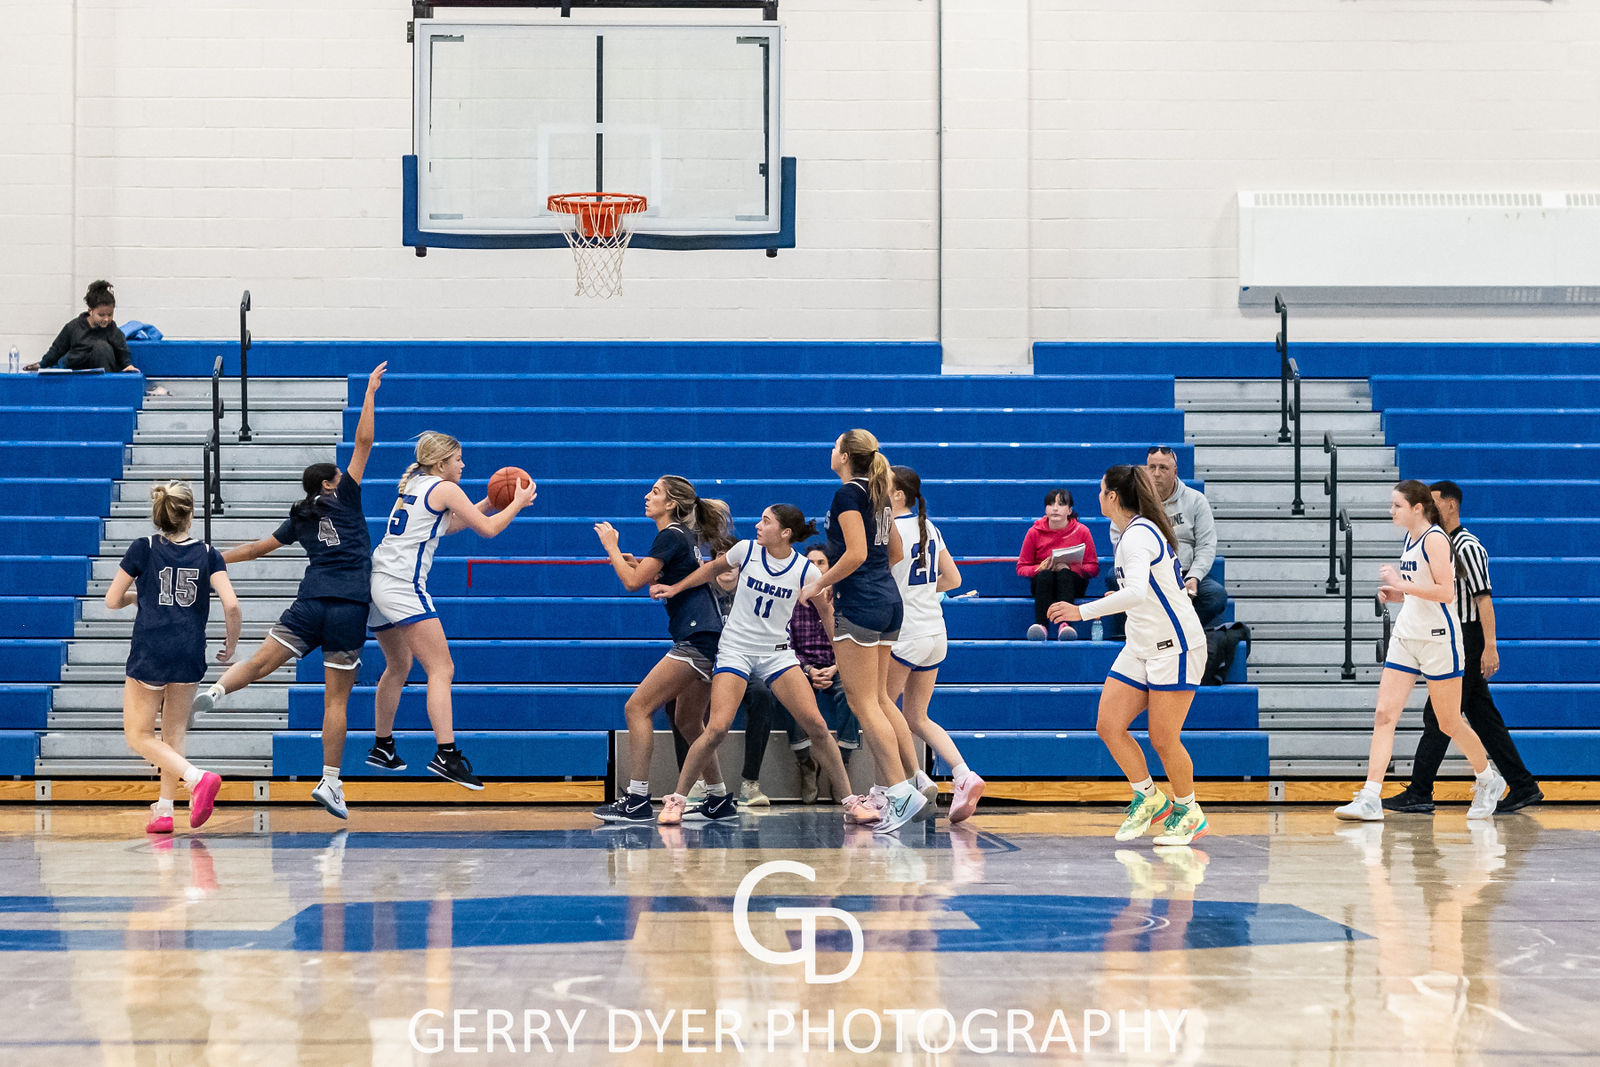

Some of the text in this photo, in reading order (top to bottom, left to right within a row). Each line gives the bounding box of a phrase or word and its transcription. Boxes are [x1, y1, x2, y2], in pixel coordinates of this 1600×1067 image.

[317, 516, 341, 547] 4
[389, 494, 418, 536] 5
[908, 539, 937, 586] 21
[158, 566, 200, 607] 15
[746, 575, 793, 599] WILDCATS
[753, 595, 774, 618] 11
